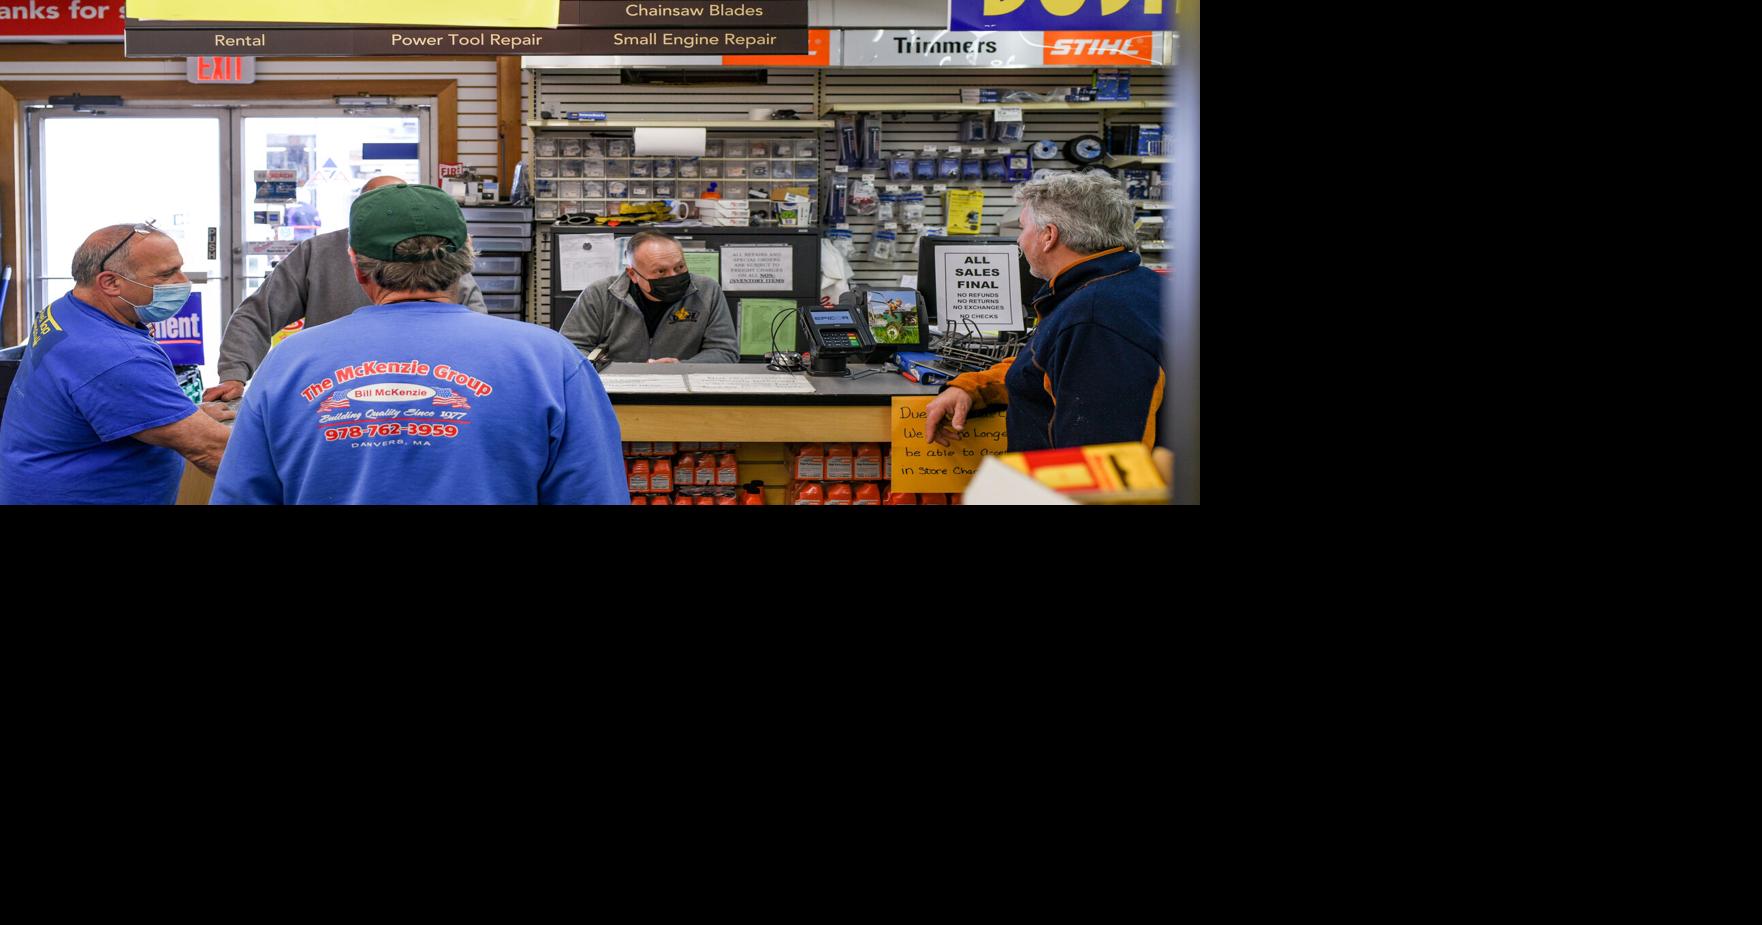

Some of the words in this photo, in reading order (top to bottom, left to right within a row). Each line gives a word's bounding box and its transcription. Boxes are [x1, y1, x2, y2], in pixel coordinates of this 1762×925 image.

[68, 0, 110, 19] for
[625, 3, 705, 18] Chainsaw
[708, 3, 764, 18] Blades
[214, 33, 266, 47] Rental
[391, 33, 444, 47] Power
[448, 33, 485, 47] Tool
[490, 33, 543, 51] Repair
[613, 32, 659, 47] Small
[662, 32, 721, 50] Engine
[724, 32, 777, 50] Repair
[893, 36, 997, 54] Trimmers
[1050, 38, 1139, 56] STIHL
[197, 56, 242, 81] EXIT
[208, 228, 216, 260] PUSH
[964, 256, 990, 264] ALL
[955, 268, 1000, 277] SALES
[957, 281, 999, 289] FINAL
[301, 378, 333, 402] The
[335, 360, 430, 383] McKenzie
[433, 363, 493, 397] Group
[354, 389, 373, 398] Bill
[375, 388, 428, 397] McKenzie
[318, 409, 362, 424] Building
[365, 407, 401, 419] Quality
[403, 408, 436, 417] Since
[439, 410, 468, 420] 1977
[899, 406, 929, 419] Due
[324, 422, 459, 442] 978-762-3959
[903, 427, 925, 439] We
[351, 440, 409, 449] DANVERS,
[905, 447, 921, 457] be
[926, 447, 956, 457] able
[962, 447, 975, 457] to
[918, 466, 949, 476] Store
